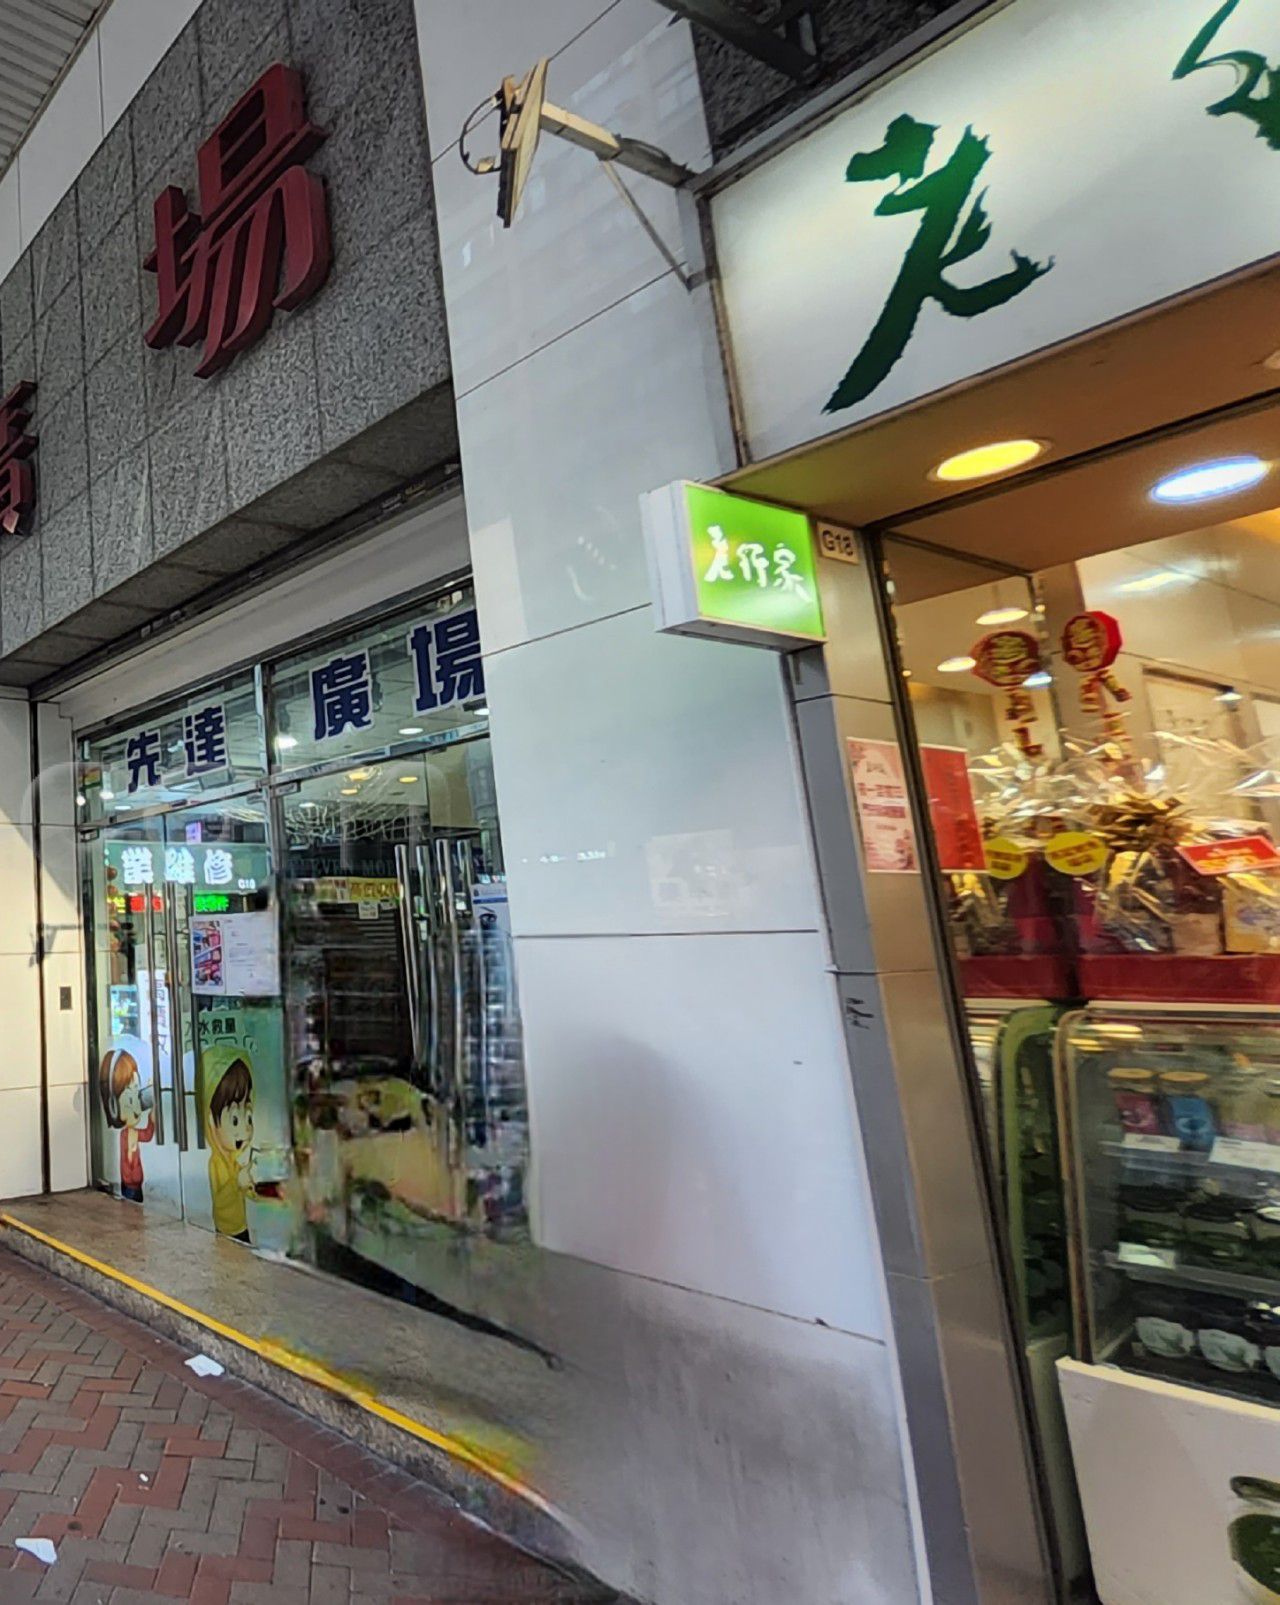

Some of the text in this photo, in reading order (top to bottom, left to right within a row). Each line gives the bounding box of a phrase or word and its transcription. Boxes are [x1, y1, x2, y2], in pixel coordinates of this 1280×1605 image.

[126, 609, 486, 794] 先達廣場
[105, 846, 233, 885] 業維修
